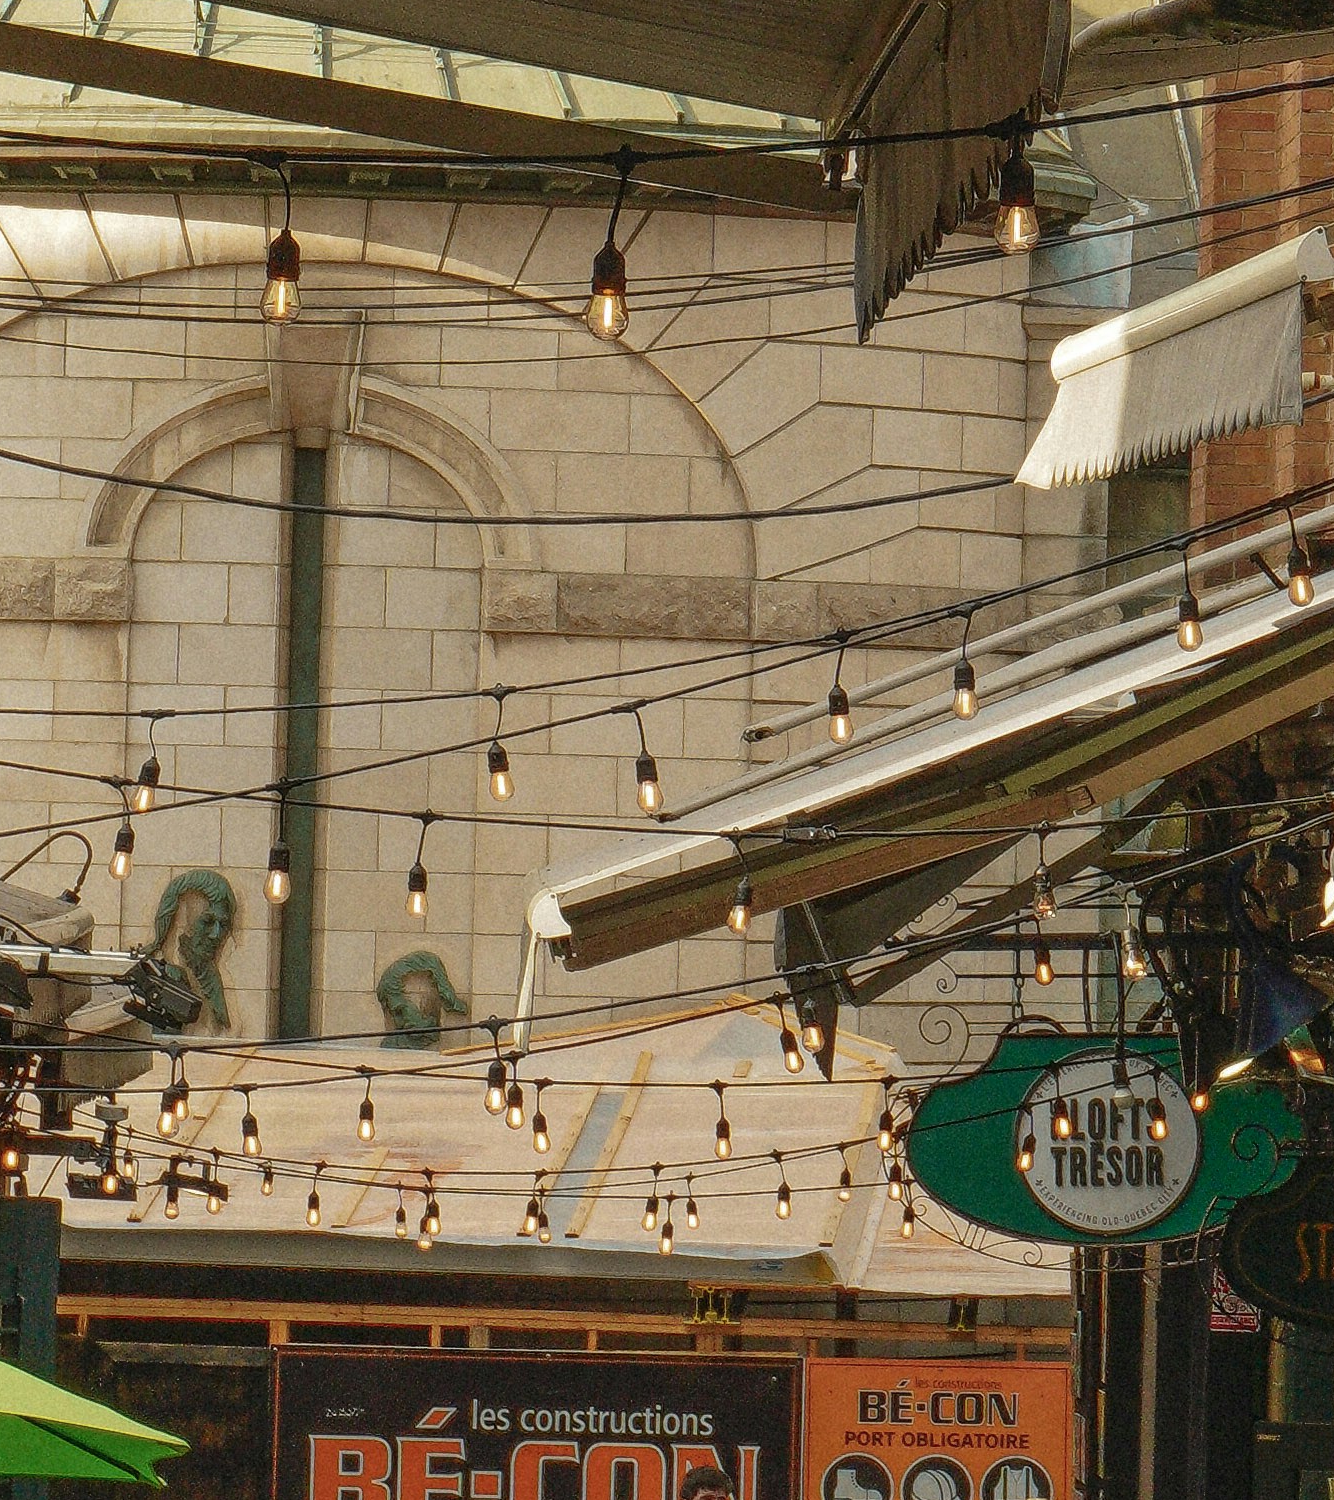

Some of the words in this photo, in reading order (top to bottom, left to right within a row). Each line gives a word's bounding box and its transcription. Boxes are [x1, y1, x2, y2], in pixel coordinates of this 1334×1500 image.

[1050, 1141, 1164, 1187] TRÉSOR
[1040, 1186, 1098, 1225] EXPERIENCING
[932, 1377, 1003, 1390] constructions
[471, 1399, 511, 1432] les
[520, 1405, 714, 1436] constructions
[857, 1379, 1020, 1428] BÉ-CON
[844, 1431, 896, 1447] PORT
[901, 1432, 1031, 1449] OBLIGATOIRE
